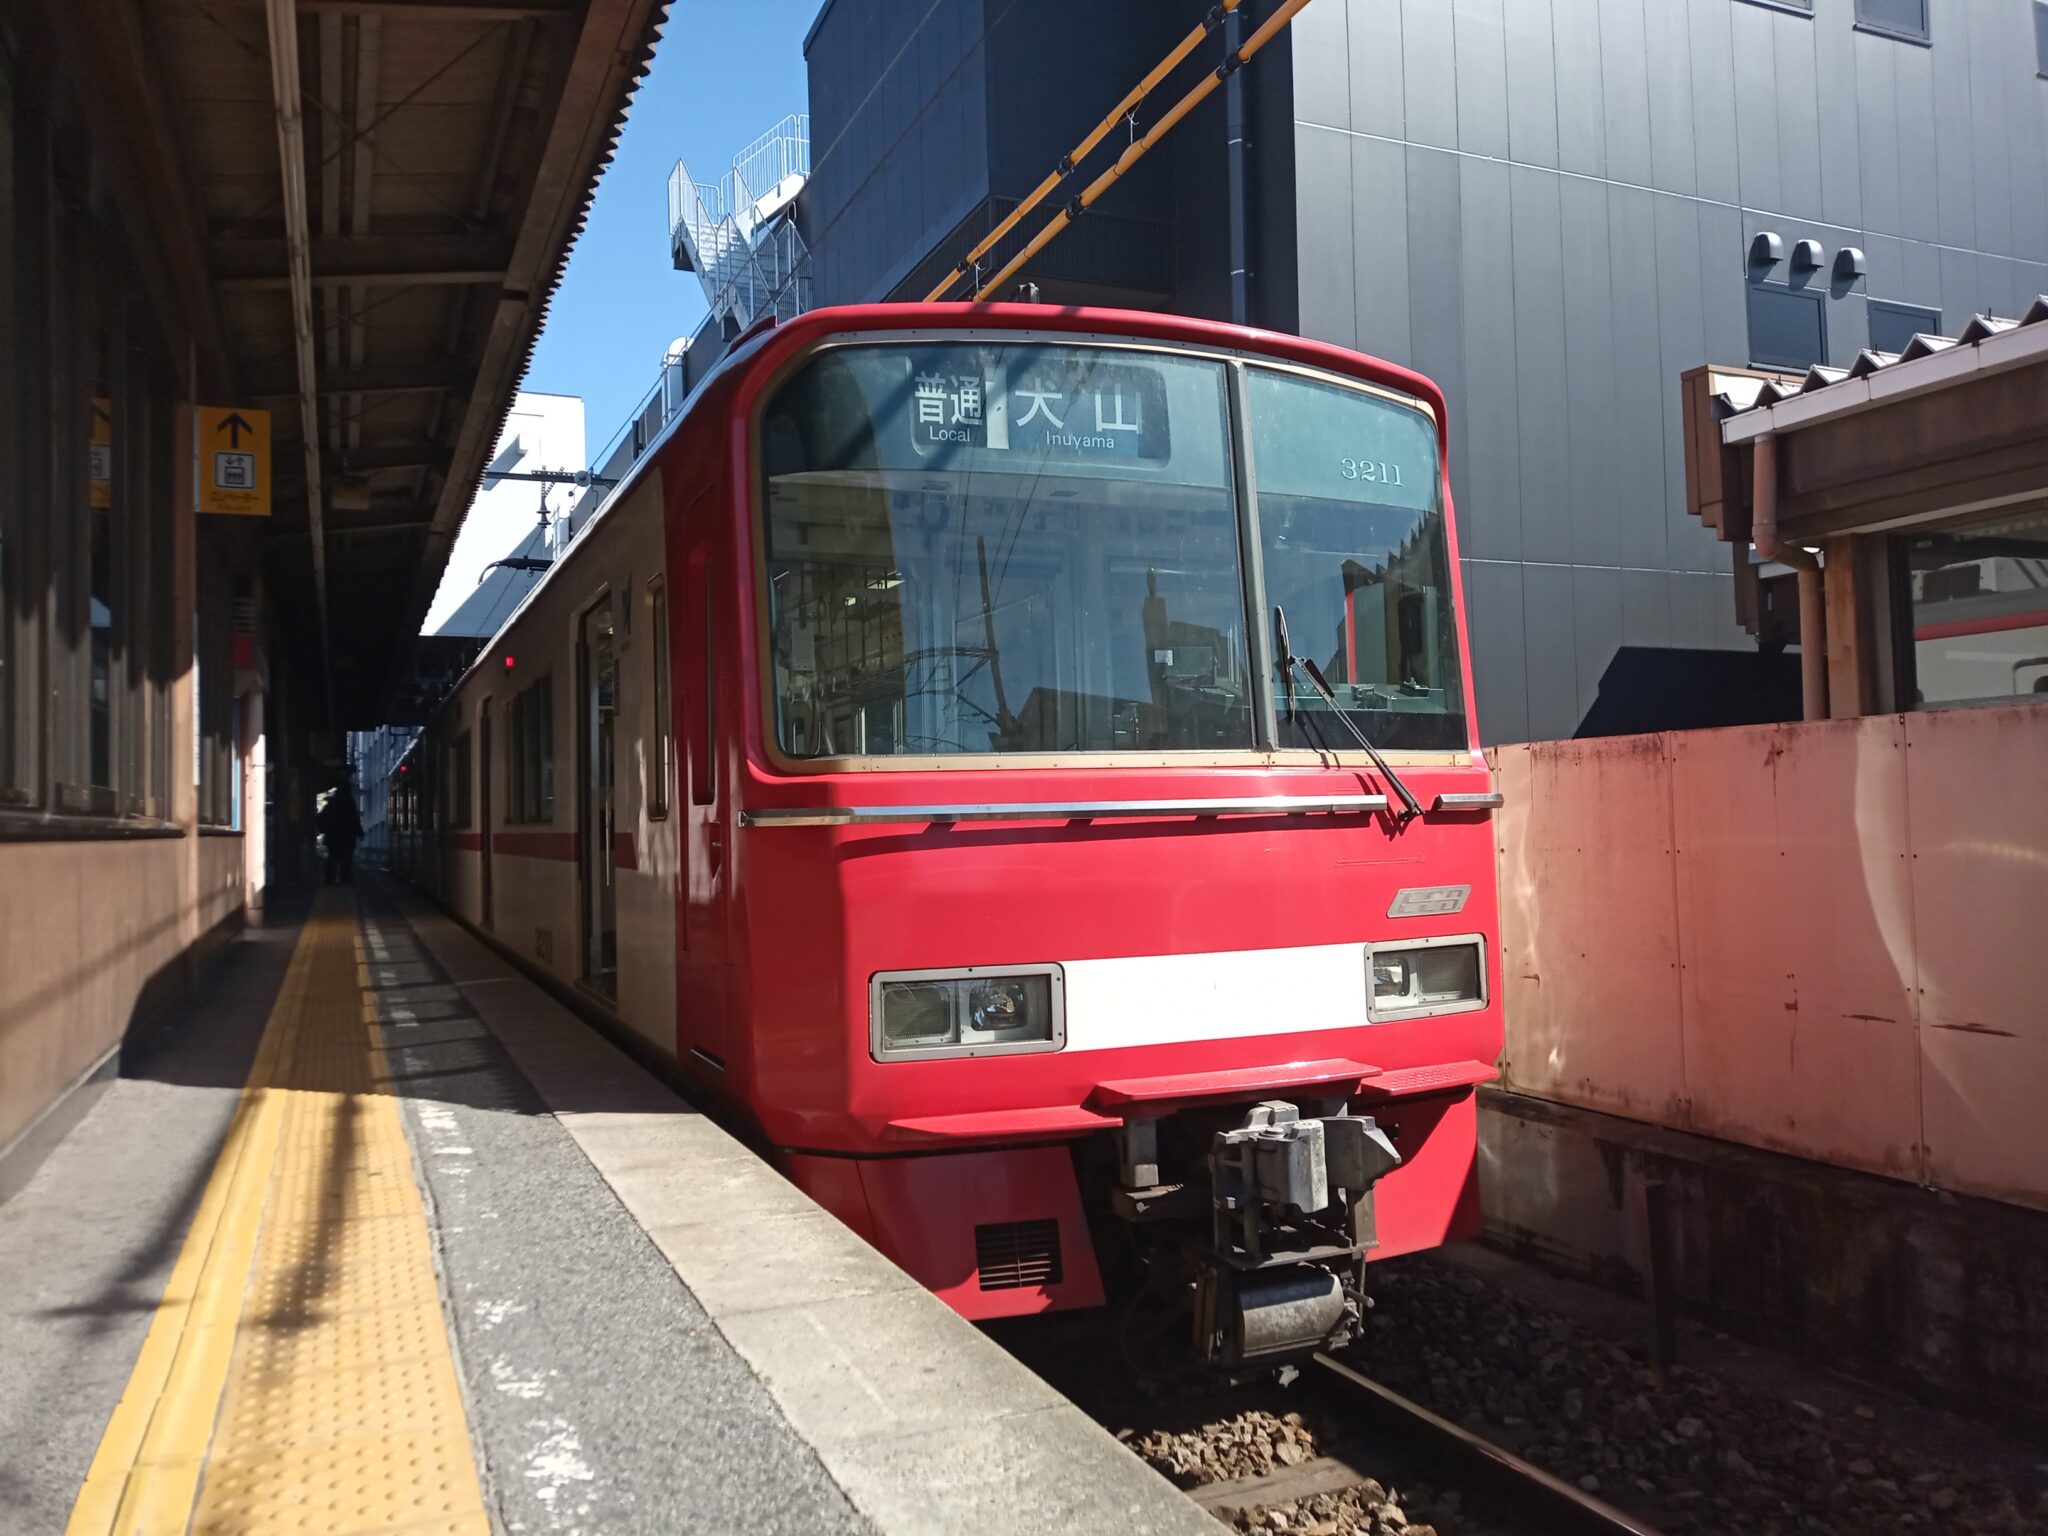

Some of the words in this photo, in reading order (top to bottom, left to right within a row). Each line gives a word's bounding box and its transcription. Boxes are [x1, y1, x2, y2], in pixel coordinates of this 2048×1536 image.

[914, 371, 983, 426] 普通
[1014, 377, 1143, 435] 犬山
[929, 425, 970, 442] Local
[1046, 431, 1115, 449] Inuyama
[1341, 457, 1403, 487] 3211
